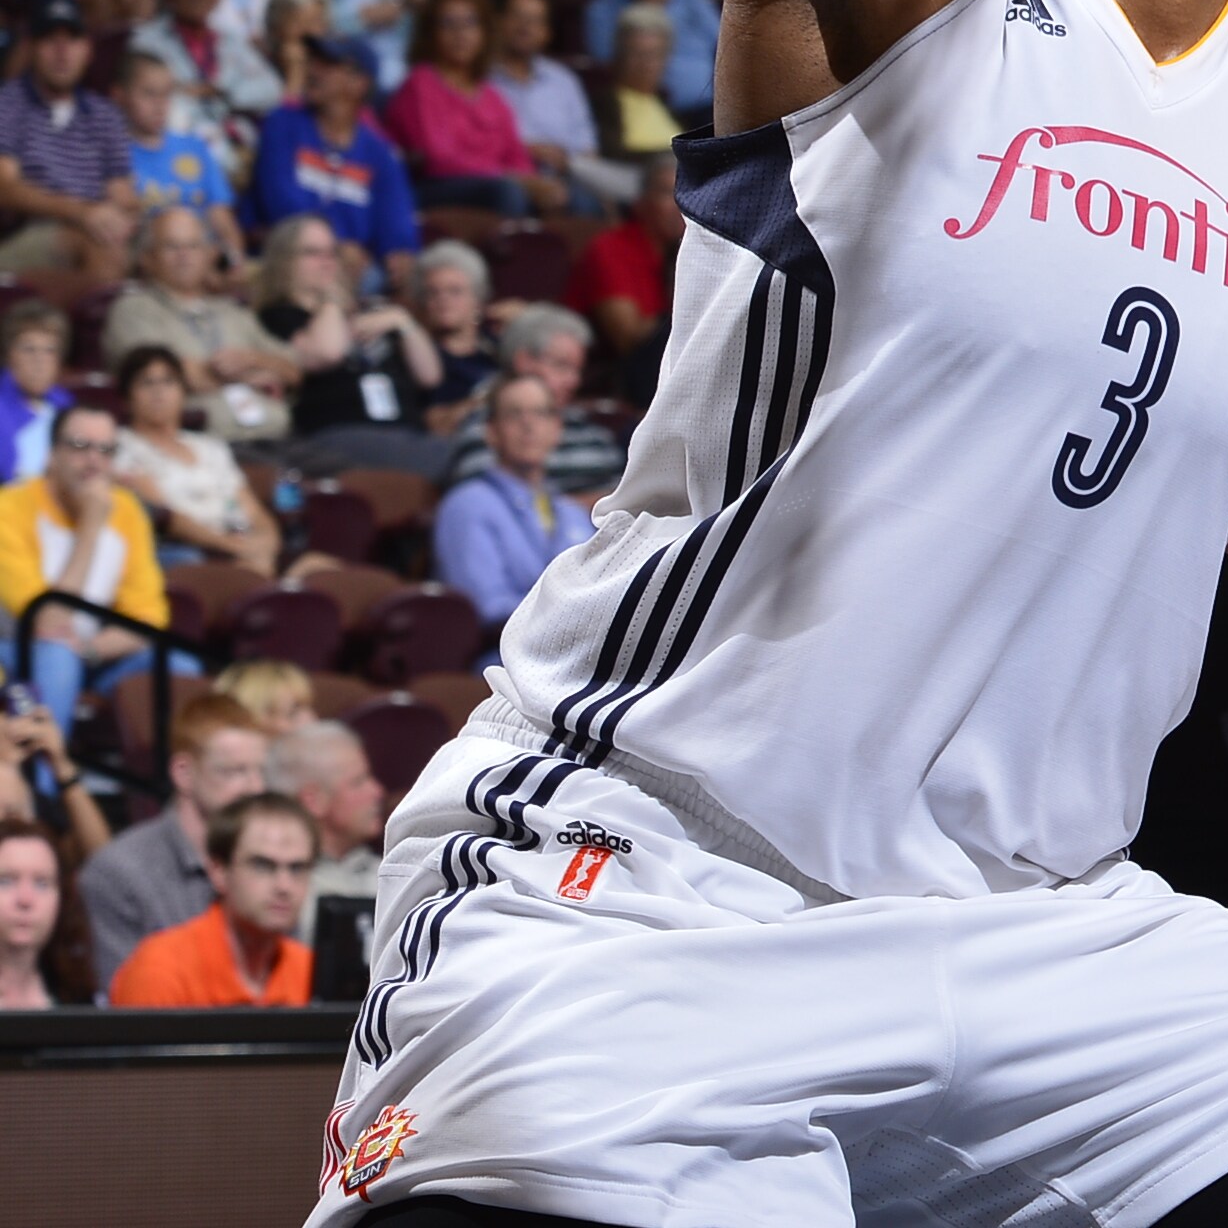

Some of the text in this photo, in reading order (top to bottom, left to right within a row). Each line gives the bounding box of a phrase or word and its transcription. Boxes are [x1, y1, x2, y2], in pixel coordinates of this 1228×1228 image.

[1051, 286, 1181, 510] 3
[556, 827, 634, 855] adidas
[348, 1161, 382, 1189] SUN
